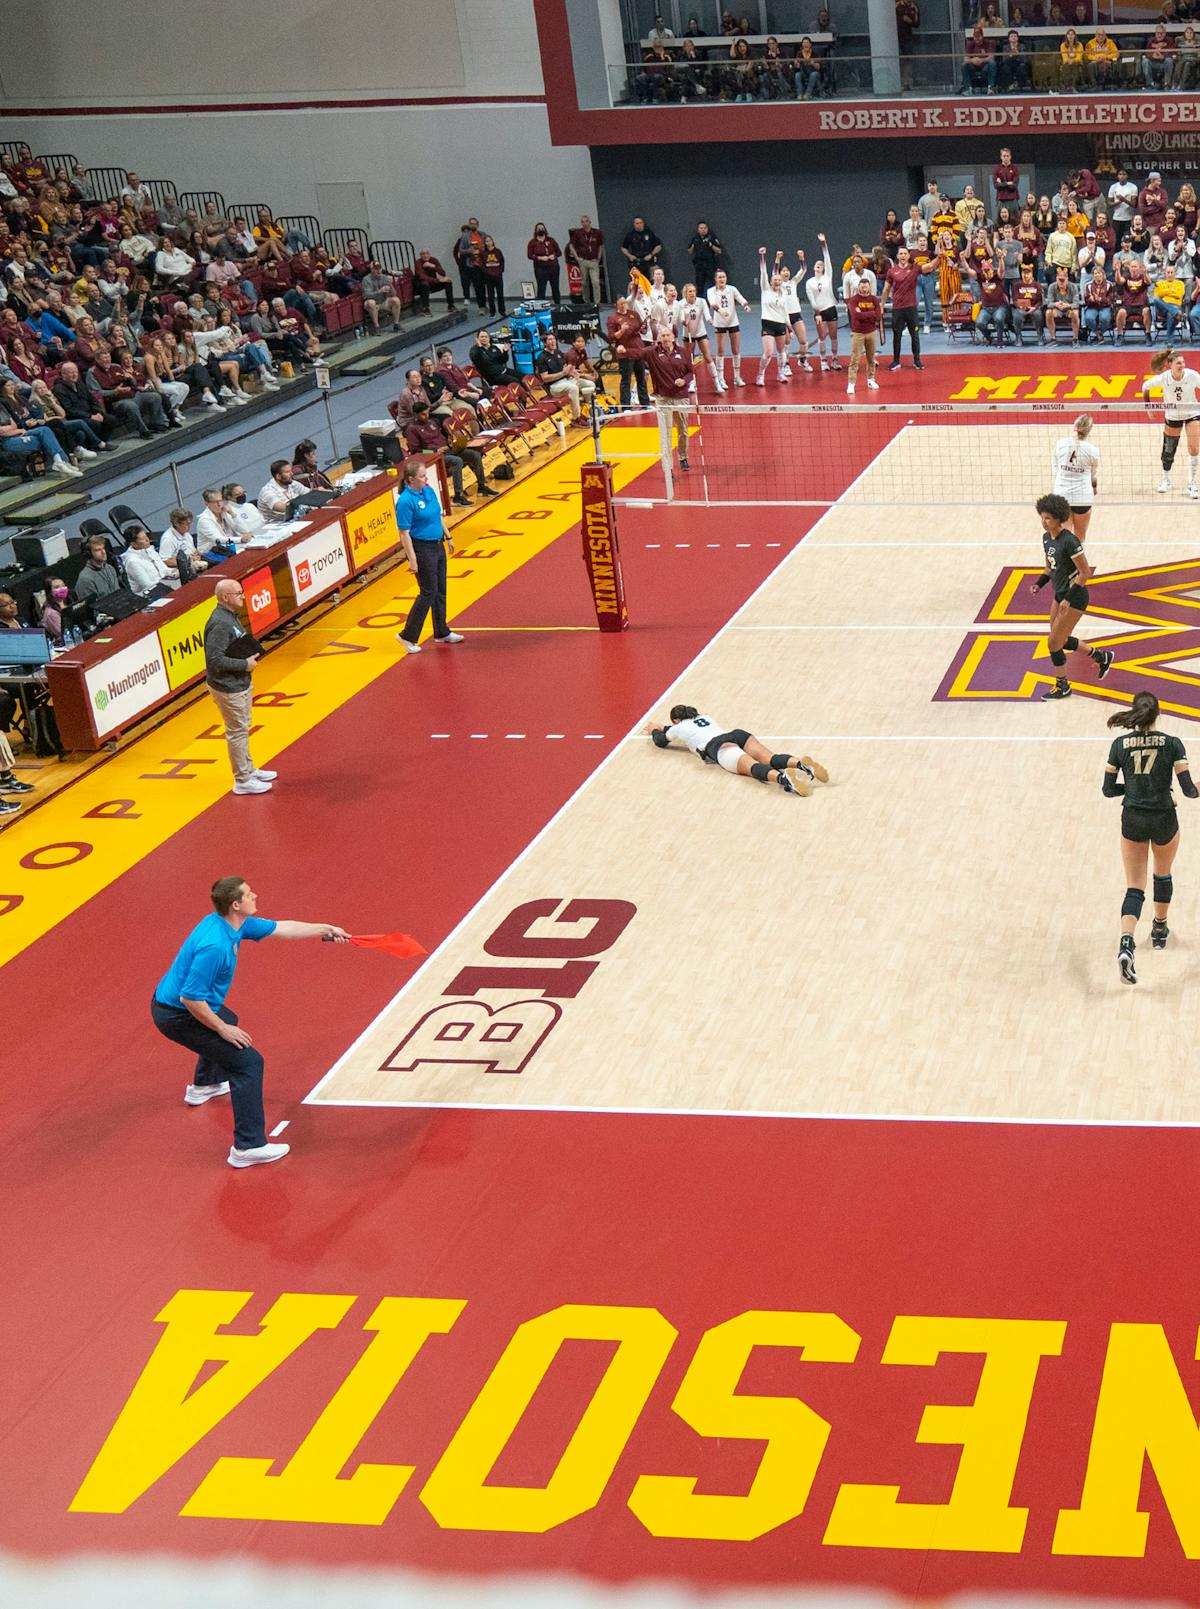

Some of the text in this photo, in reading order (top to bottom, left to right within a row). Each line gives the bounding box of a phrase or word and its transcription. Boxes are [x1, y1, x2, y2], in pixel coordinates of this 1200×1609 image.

[818, 109, 918, 131] ROBERT
[923, 107, 949, 129] K.
[953, 106, 1024, 127] EDDY
[1028, 103, 1157, 126] ATHLETIC
[1105, 134, 1141, 150] LAND
[1135, 160, 1181, 170] GOPHER
[557, 323, 582, 331] molten
[1176, 392, 1182, 402] 5
[367, 510, 392, 532] HEALTH
[311, 547, 344, 575] TOYOTA
[585, 501, 618, 615] MINNESOTA
[251, 588, 272, 612] Cub
[107, 658, 161, 701] Huntington
[693, 717, 711, 728] 8
[1122, 735, 1167, 749] BOILERS
[1130, 748, 1158, 775] 17
